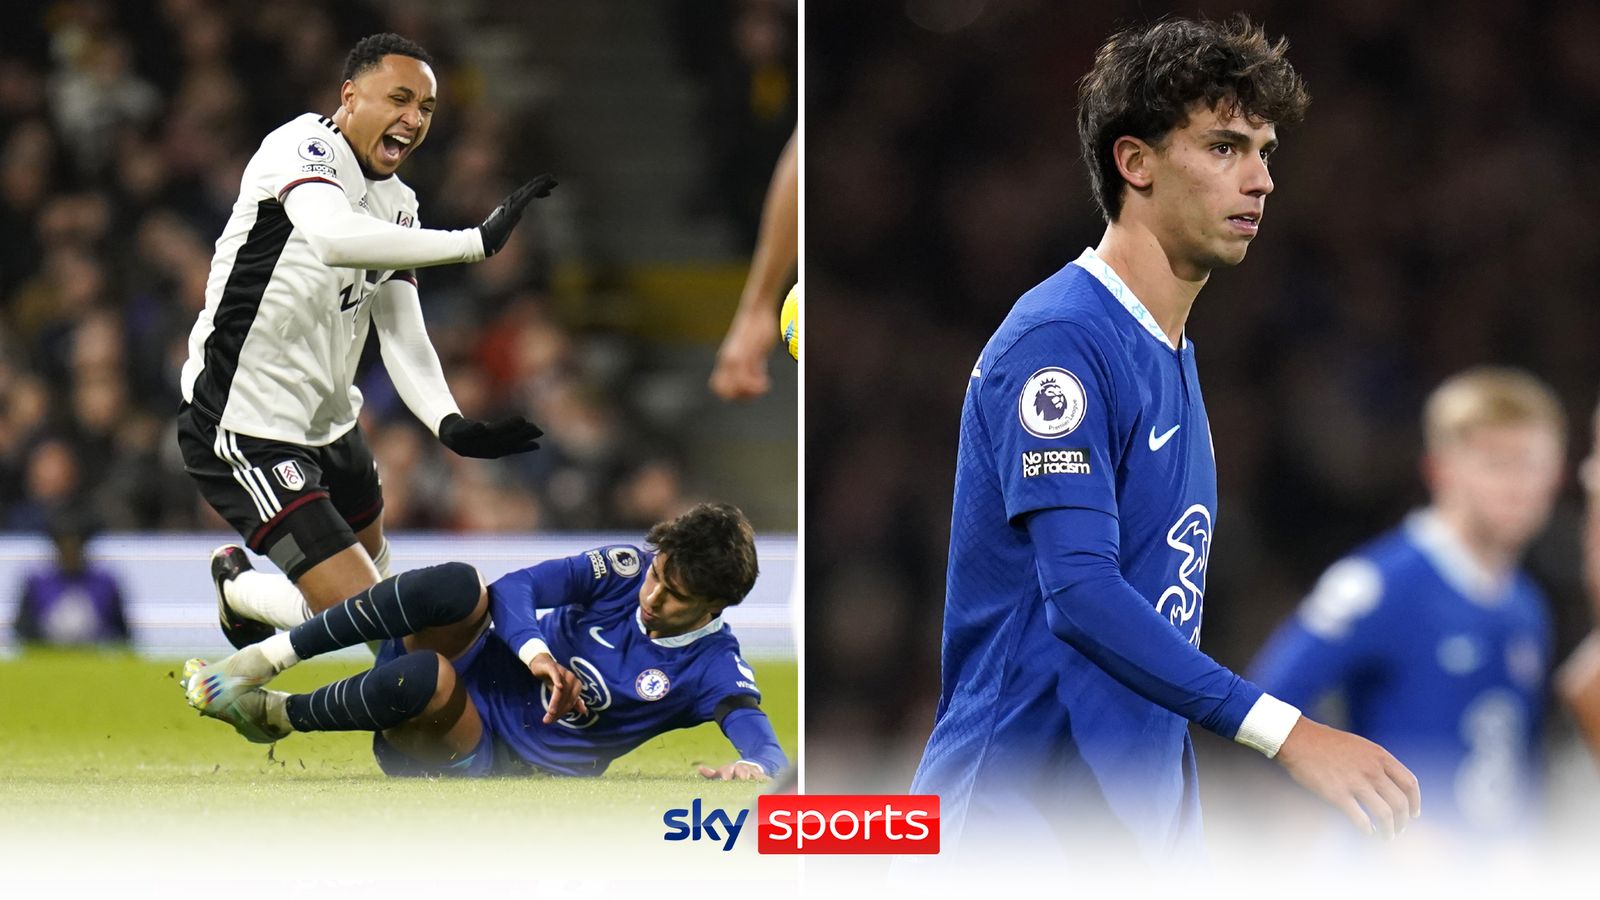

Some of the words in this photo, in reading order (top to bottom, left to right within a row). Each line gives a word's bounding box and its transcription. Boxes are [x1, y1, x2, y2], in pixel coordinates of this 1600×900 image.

[1065, 399, 1079, 421] League
[1022, 451, 1042, 465] No
[1044, 450, 1084, 463] room
[1044, 462, 1090, 475] racism
